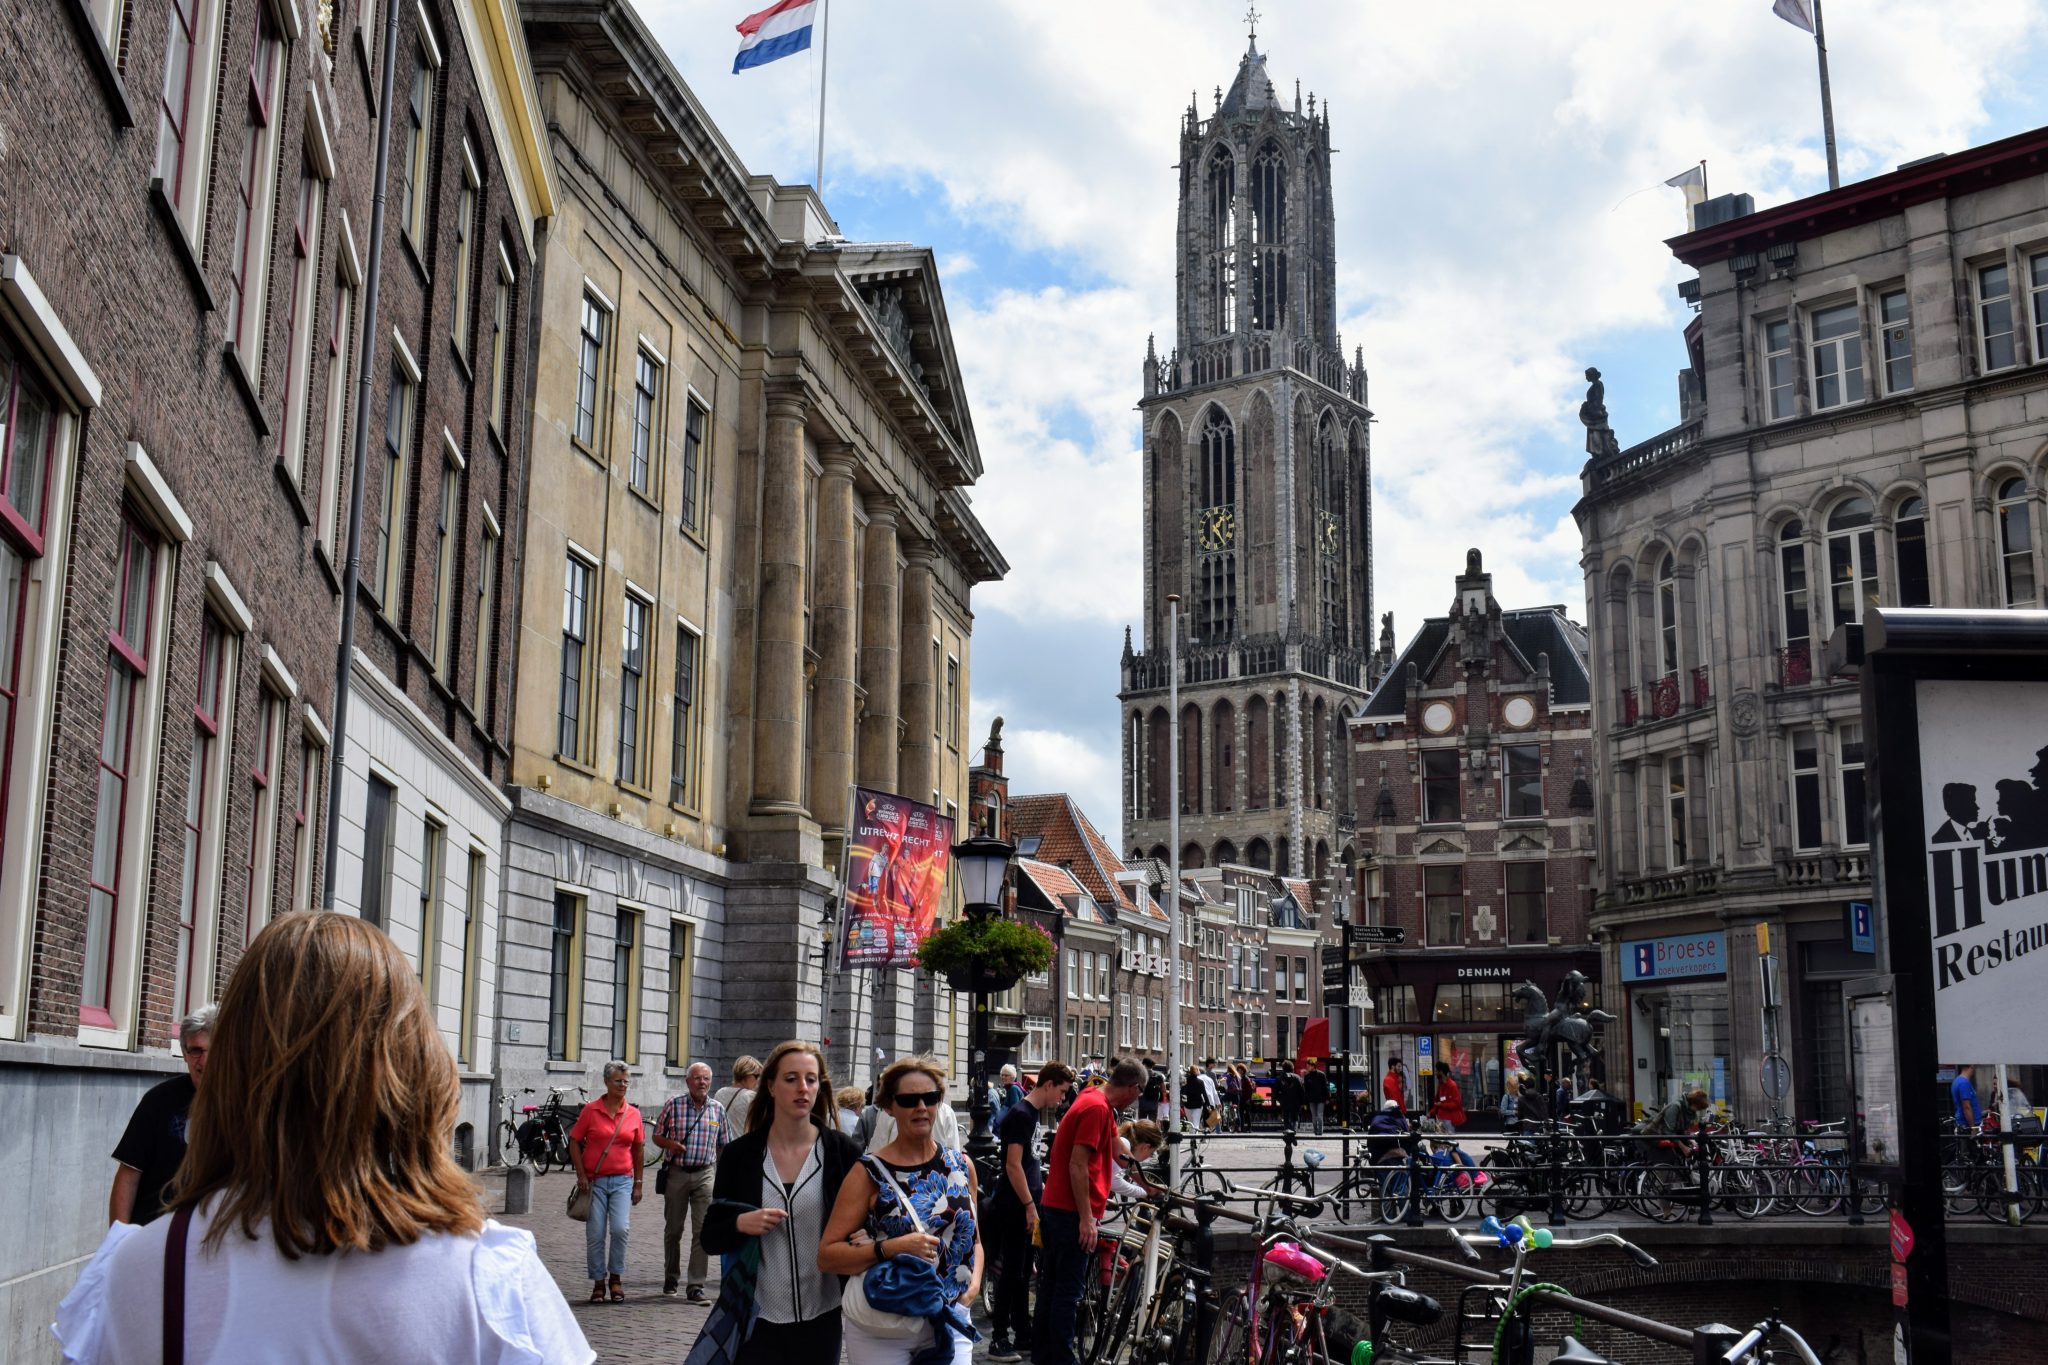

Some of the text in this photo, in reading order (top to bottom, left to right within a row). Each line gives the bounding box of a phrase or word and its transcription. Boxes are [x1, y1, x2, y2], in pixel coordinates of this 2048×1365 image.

[901, 835, 931, 847] RECHT
[1657, 940, 1716, 961] Broese
[1457, 967, 1511, 977] DENHAM
[1658, 962, 1717, 976] boekverkopers
[1421, 1038, 1429, 1049] P
